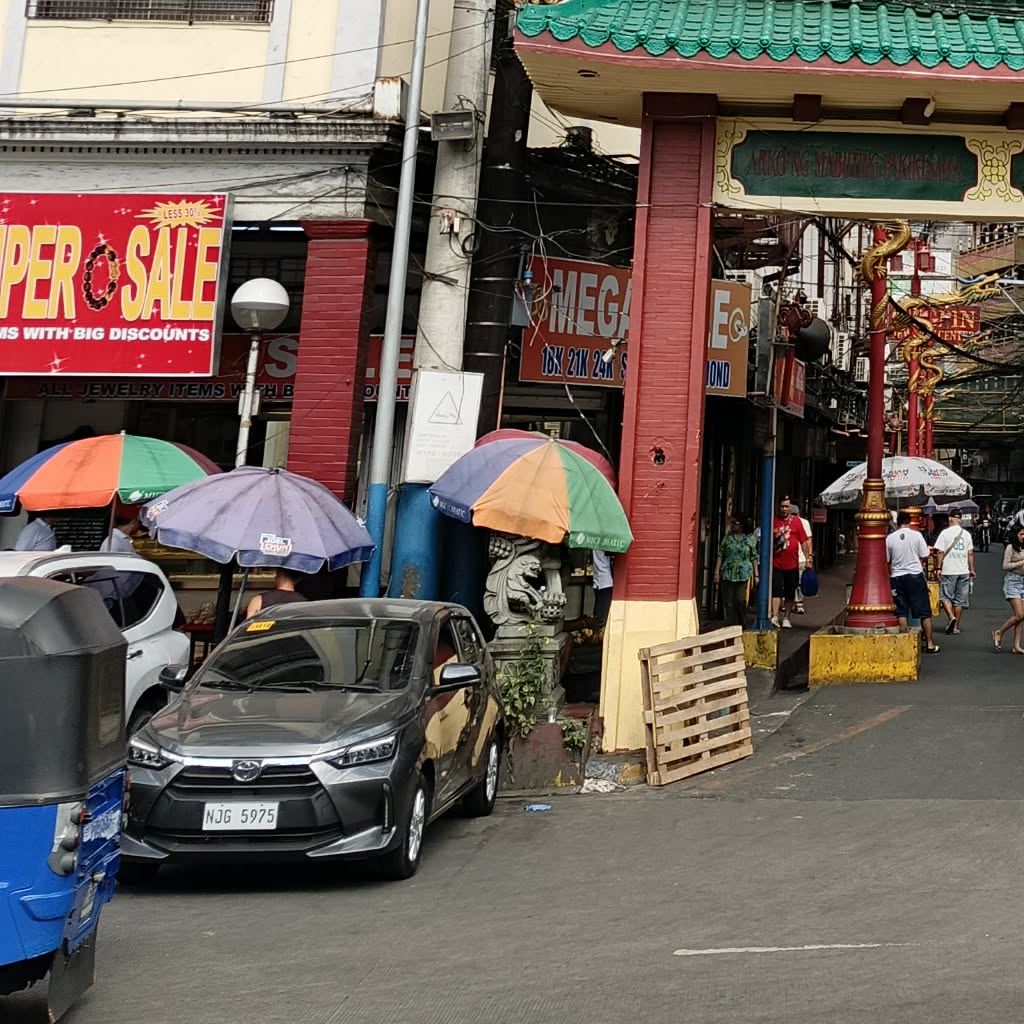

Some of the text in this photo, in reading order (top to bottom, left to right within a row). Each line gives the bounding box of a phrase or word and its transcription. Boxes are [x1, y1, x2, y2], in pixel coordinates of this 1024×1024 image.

[163, 208, 183, 220] LESS
[0, 224, 222, 322] PER SALE
[22, 326, 70, 340] WITH
[73, 327, 105, 340] BIG
[108, 327, 210, 342] DISCOUNTS
[567, 347, 589, 377] 21K
[38, 383, 72, 396] ALL
[78, 383, 164, 397] JEWELRY
[168, 384, 226, 397] ITEMS
[205, 808, 275, 824] NJG 5975
